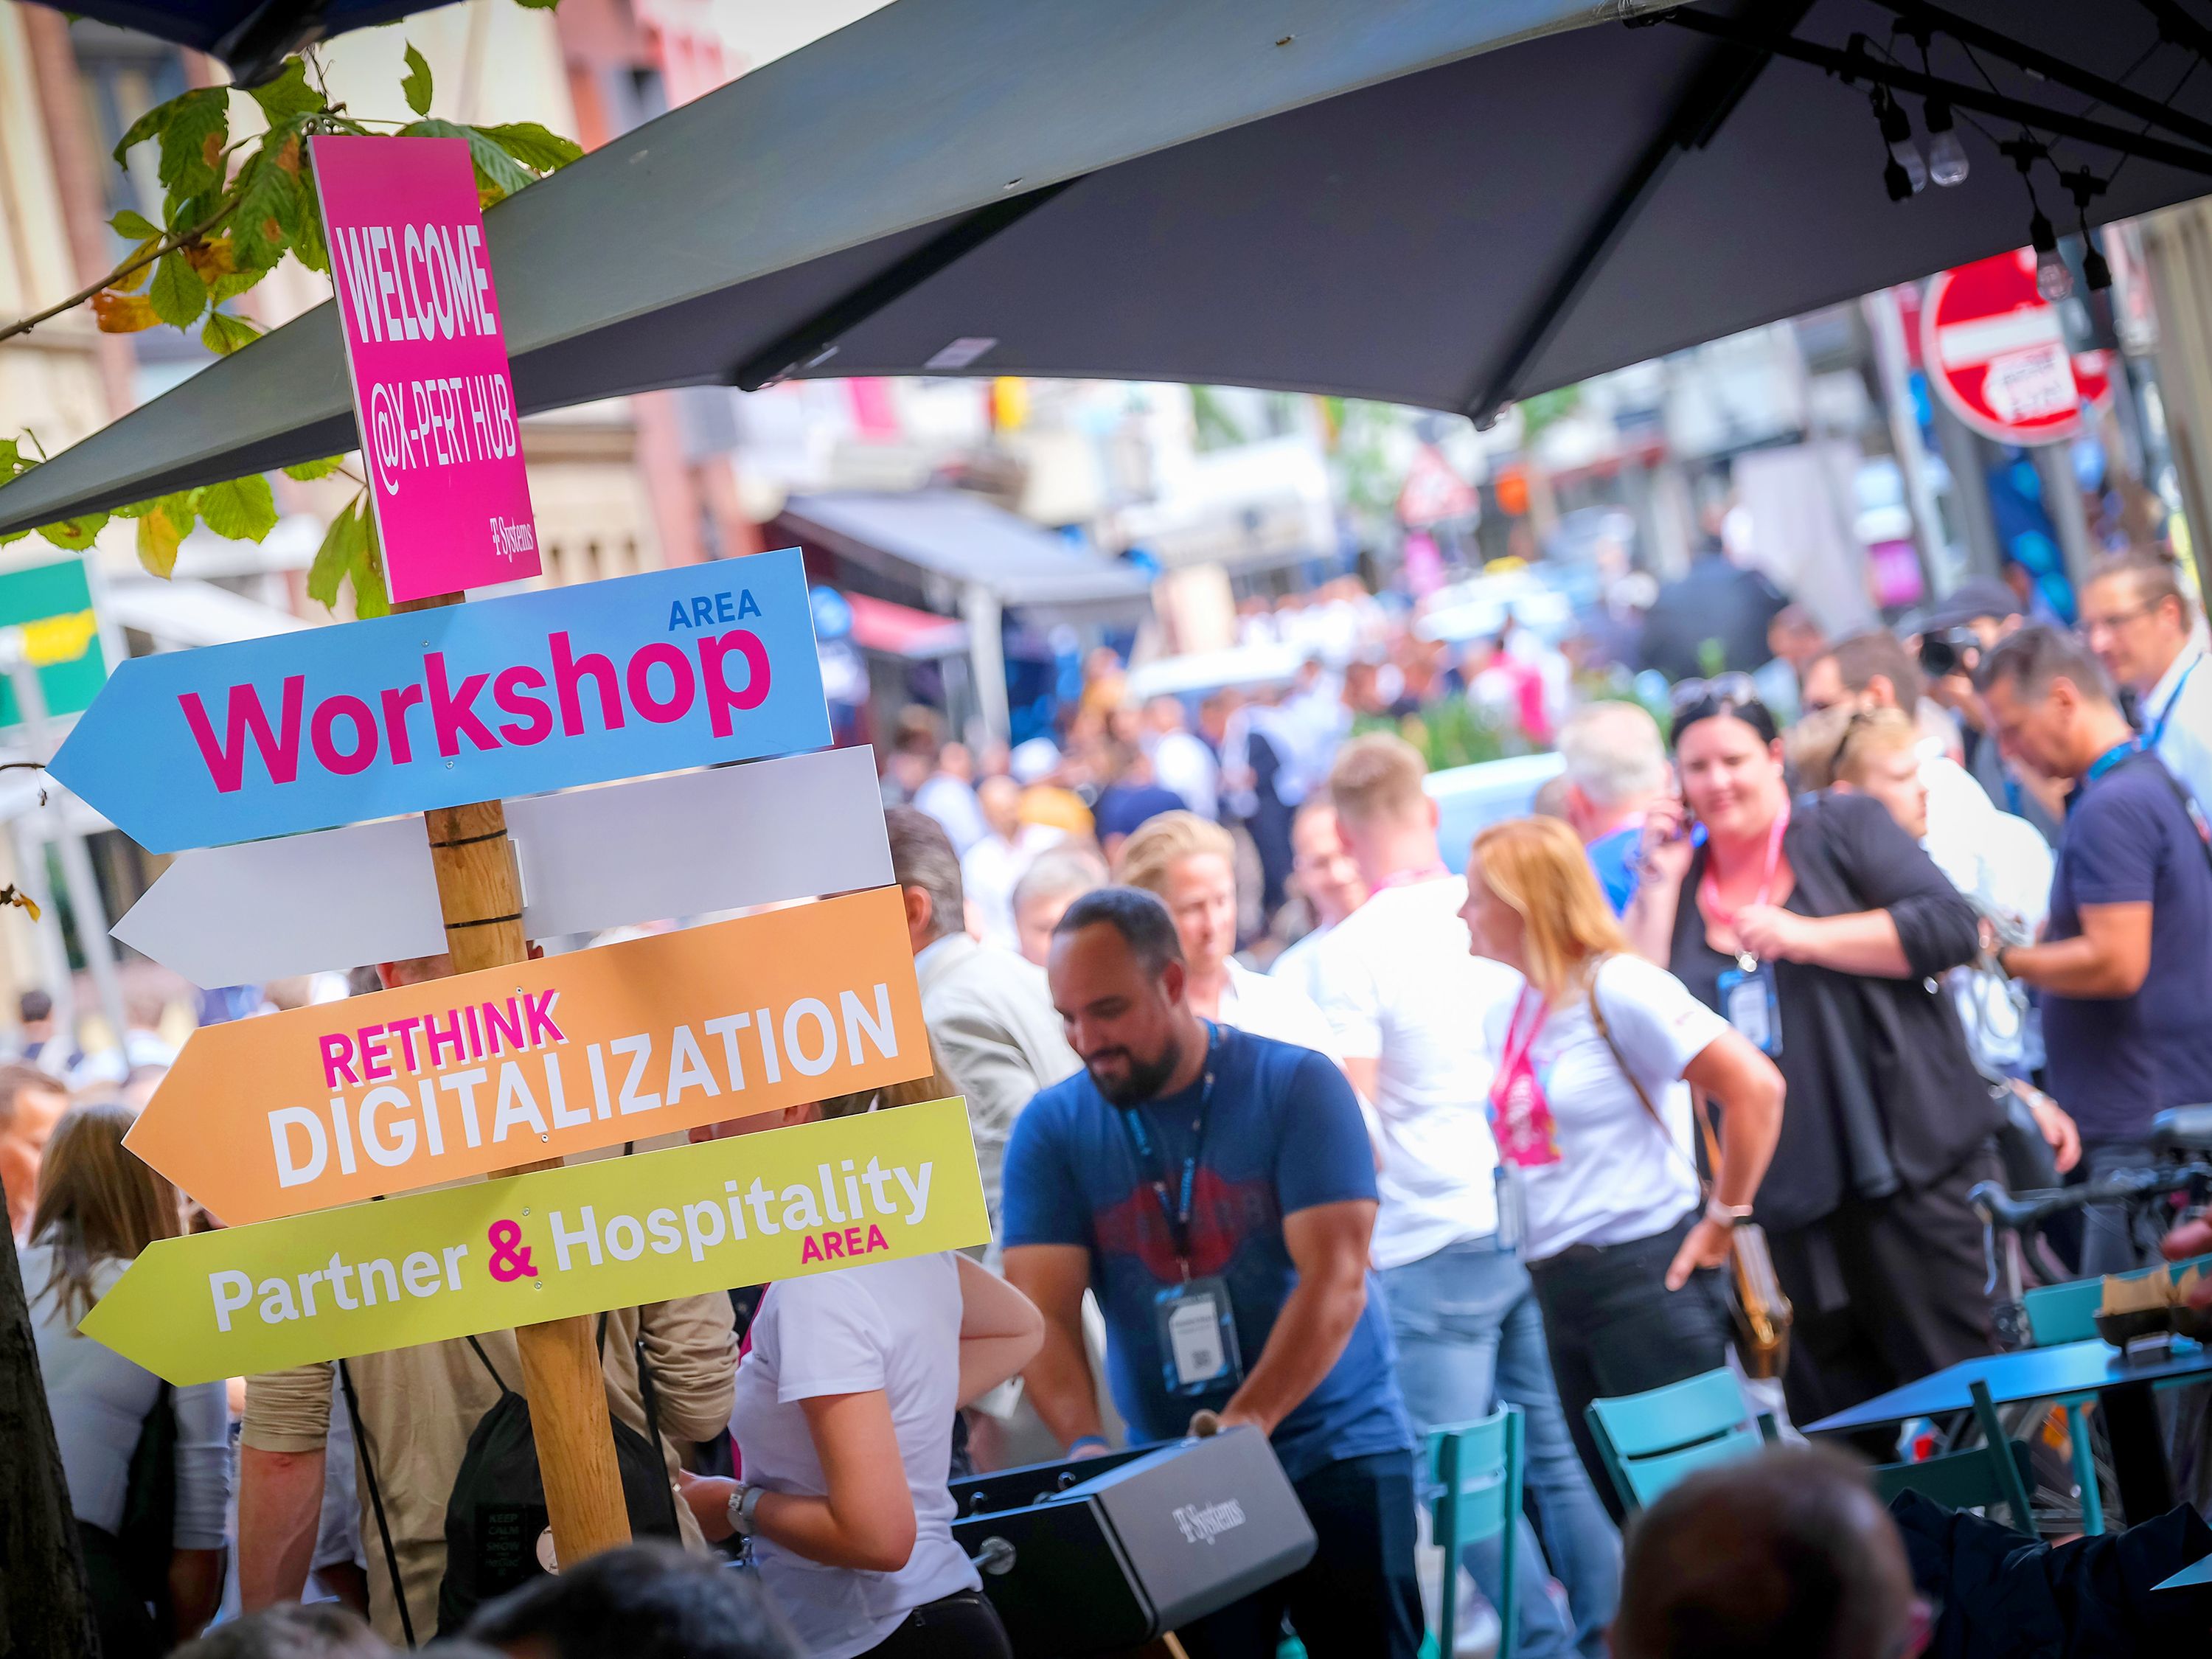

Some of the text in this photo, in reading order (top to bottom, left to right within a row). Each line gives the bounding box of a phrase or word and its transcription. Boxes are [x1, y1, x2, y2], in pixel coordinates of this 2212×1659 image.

[335, 223, 497, 343] WELCOME
[371, 373, 516, 495] @X-PERT HUB
[668, 588, 762, 632] AREA
[178, 630, 771, 793] Workshop
[267, 982, 900, 1189] DIGITALIZATION
[319, 989, 566, 1091] RETHINK
[208, 1155, 933, 1333] Partner & Hospitality
[801, 1224, 889, 1264] AREA
[487, 1526, 520, 1535] CALM
[488, 1513, 518, 1523] KEEP
